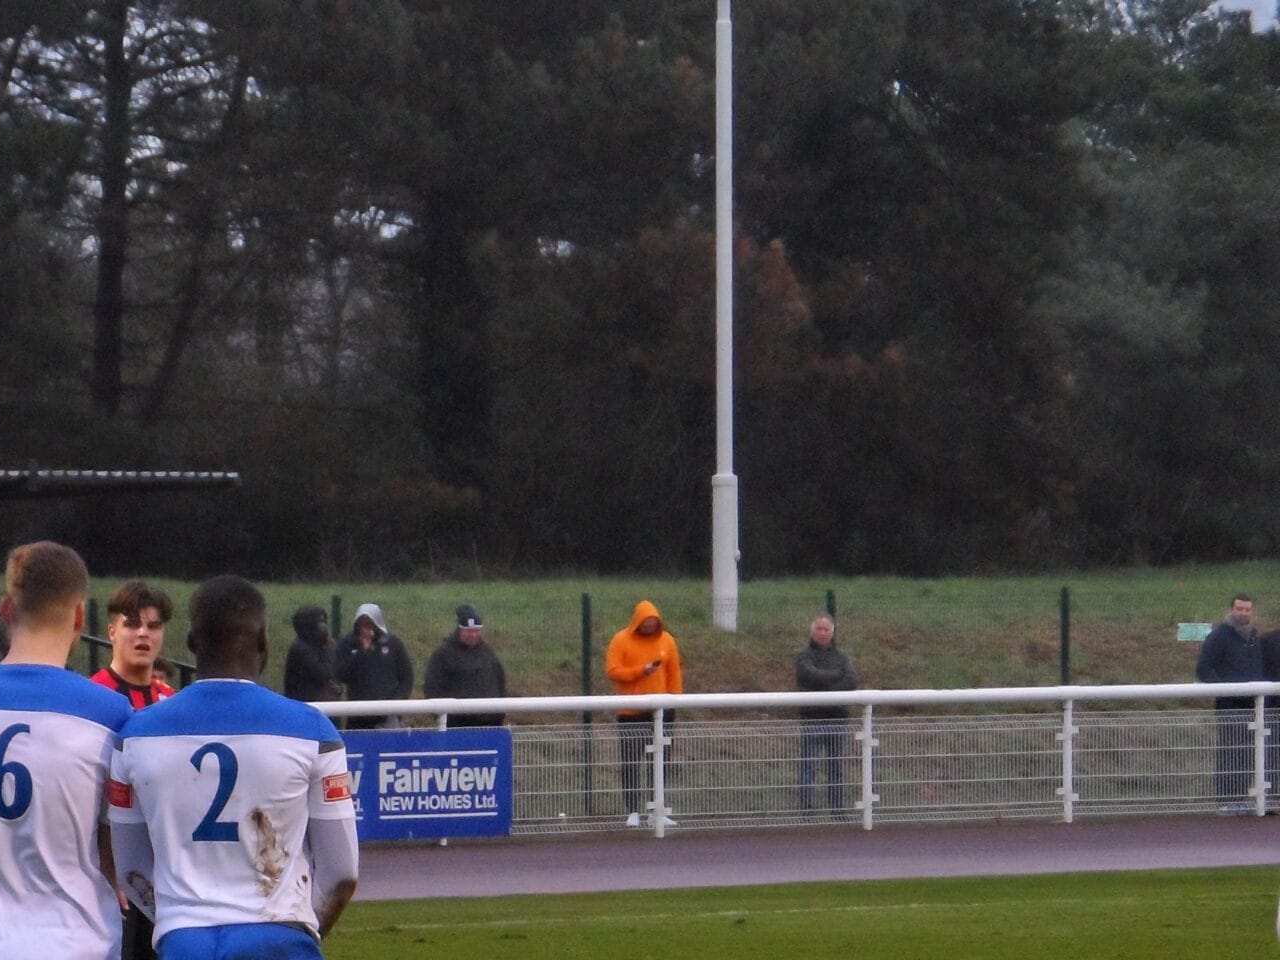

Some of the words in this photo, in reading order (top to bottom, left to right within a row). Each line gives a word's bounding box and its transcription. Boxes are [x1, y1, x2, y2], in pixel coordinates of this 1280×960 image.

[190, 742, 240, 842] 2
[378, 758, 497, 794] Fairview
[378, 796, 415, 812] NEW
[417, 795, 472, 811] HOMES
[474, 794, 499, 809] Ltd.
